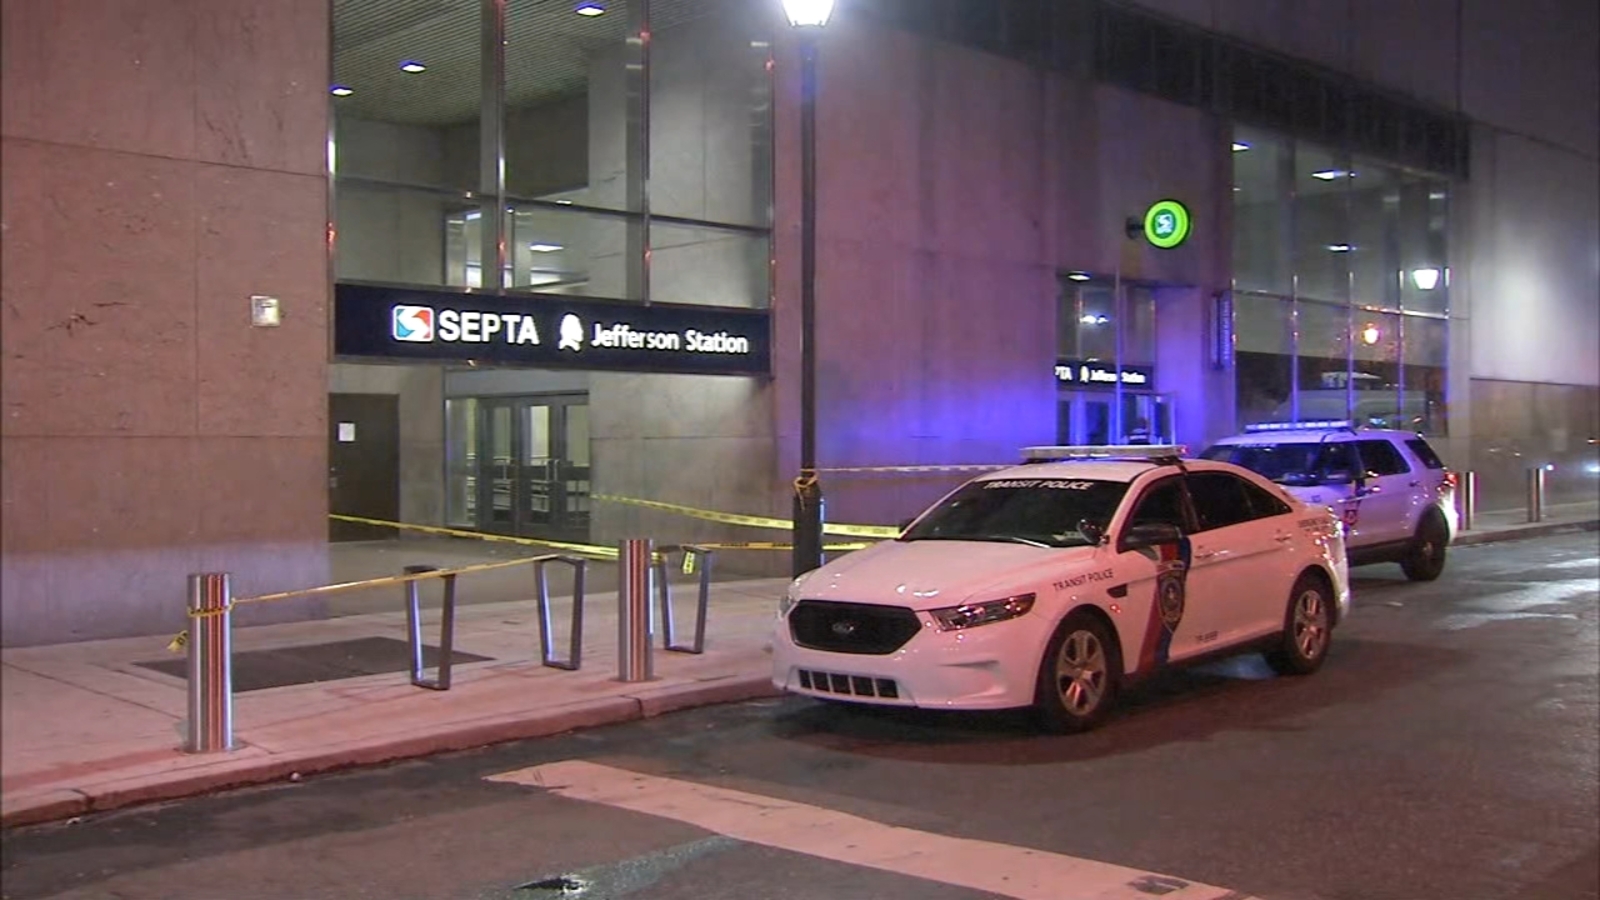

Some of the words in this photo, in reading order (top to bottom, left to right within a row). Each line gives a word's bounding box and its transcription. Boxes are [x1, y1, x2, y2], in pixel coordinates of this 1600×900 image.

[438, 309, 540, 346] SEPTA
[590, 322, 680, 351] Jefferson
[684, 329, 749, 354] Station
[983, 479, 1041, 490] TRANSIT
[1038, 480, 1095, 491] POLICE
[1053, 574, 1086, 592] TRANSIT
[1086, 567, 1114, 583] POLICE
